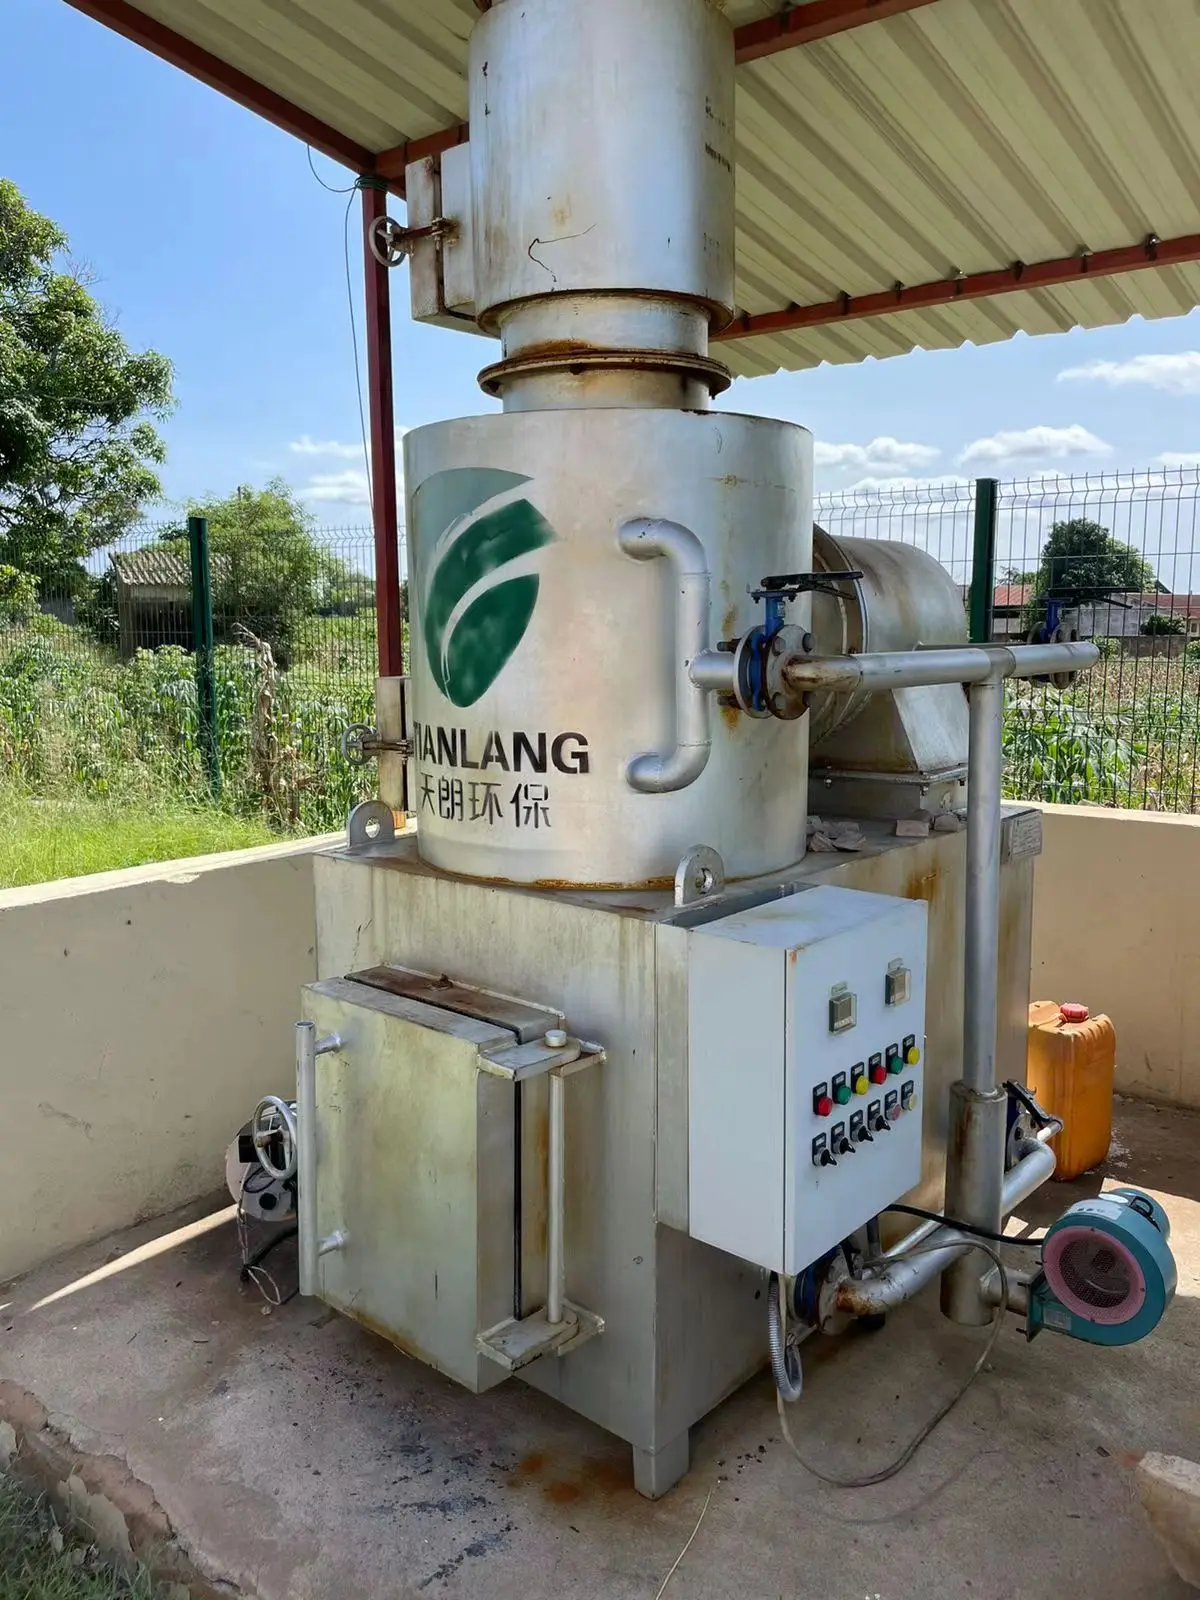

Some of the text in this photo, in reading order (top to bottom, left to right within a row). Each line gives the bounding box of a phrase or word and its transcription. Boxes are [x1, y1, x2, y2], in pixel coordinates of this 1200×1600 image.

[413, 721, 590, 774] TIANLANG
[420, 772, 551, 828] 天朗环保
